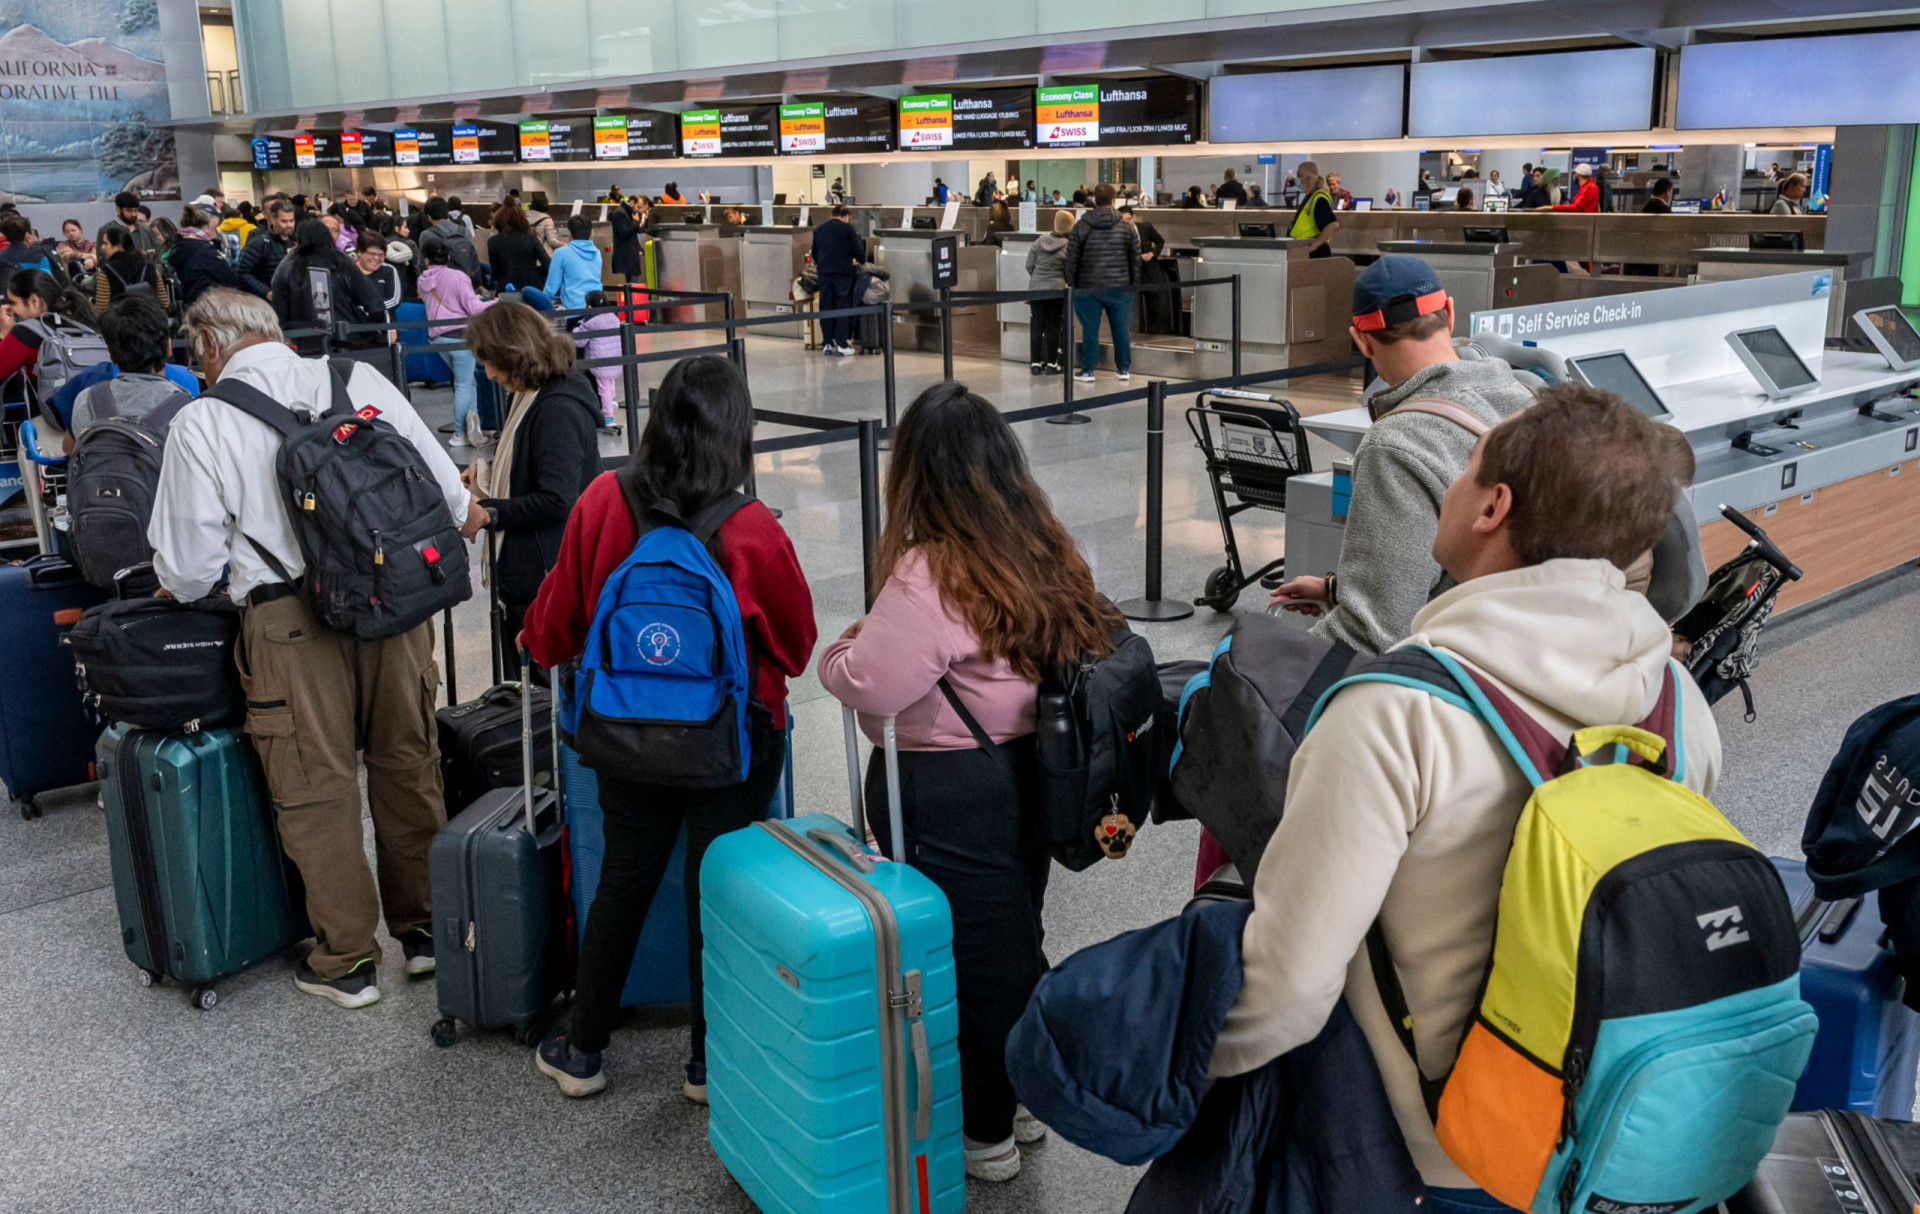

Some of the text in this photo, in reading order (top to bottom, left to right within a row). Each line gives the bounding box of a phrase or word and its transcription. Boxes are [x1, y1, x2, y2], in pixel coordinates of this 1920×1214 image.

[0, 84, 121, 101] ORATIVE TILE
[1041, 91, 1094, 102] Economy Class
[1100, 90, 1147, 102] Lufthansa
[903, 99, 948, 109] Economy Class
[953, 99, 993, 110] Lufthansa
[824, 107, 858, 117] Lufthansa
[1056, 110, 1093, 119] Lufthansa
[720, 114, 749, 123] Lufthansa
[1061, 127, 1087, 136] SWISS
[798, 138, 816, 146] SWISS
[921, 133, 942, 141] SWISS
[1517, 301, 1642, 335] Self Service Check-in
